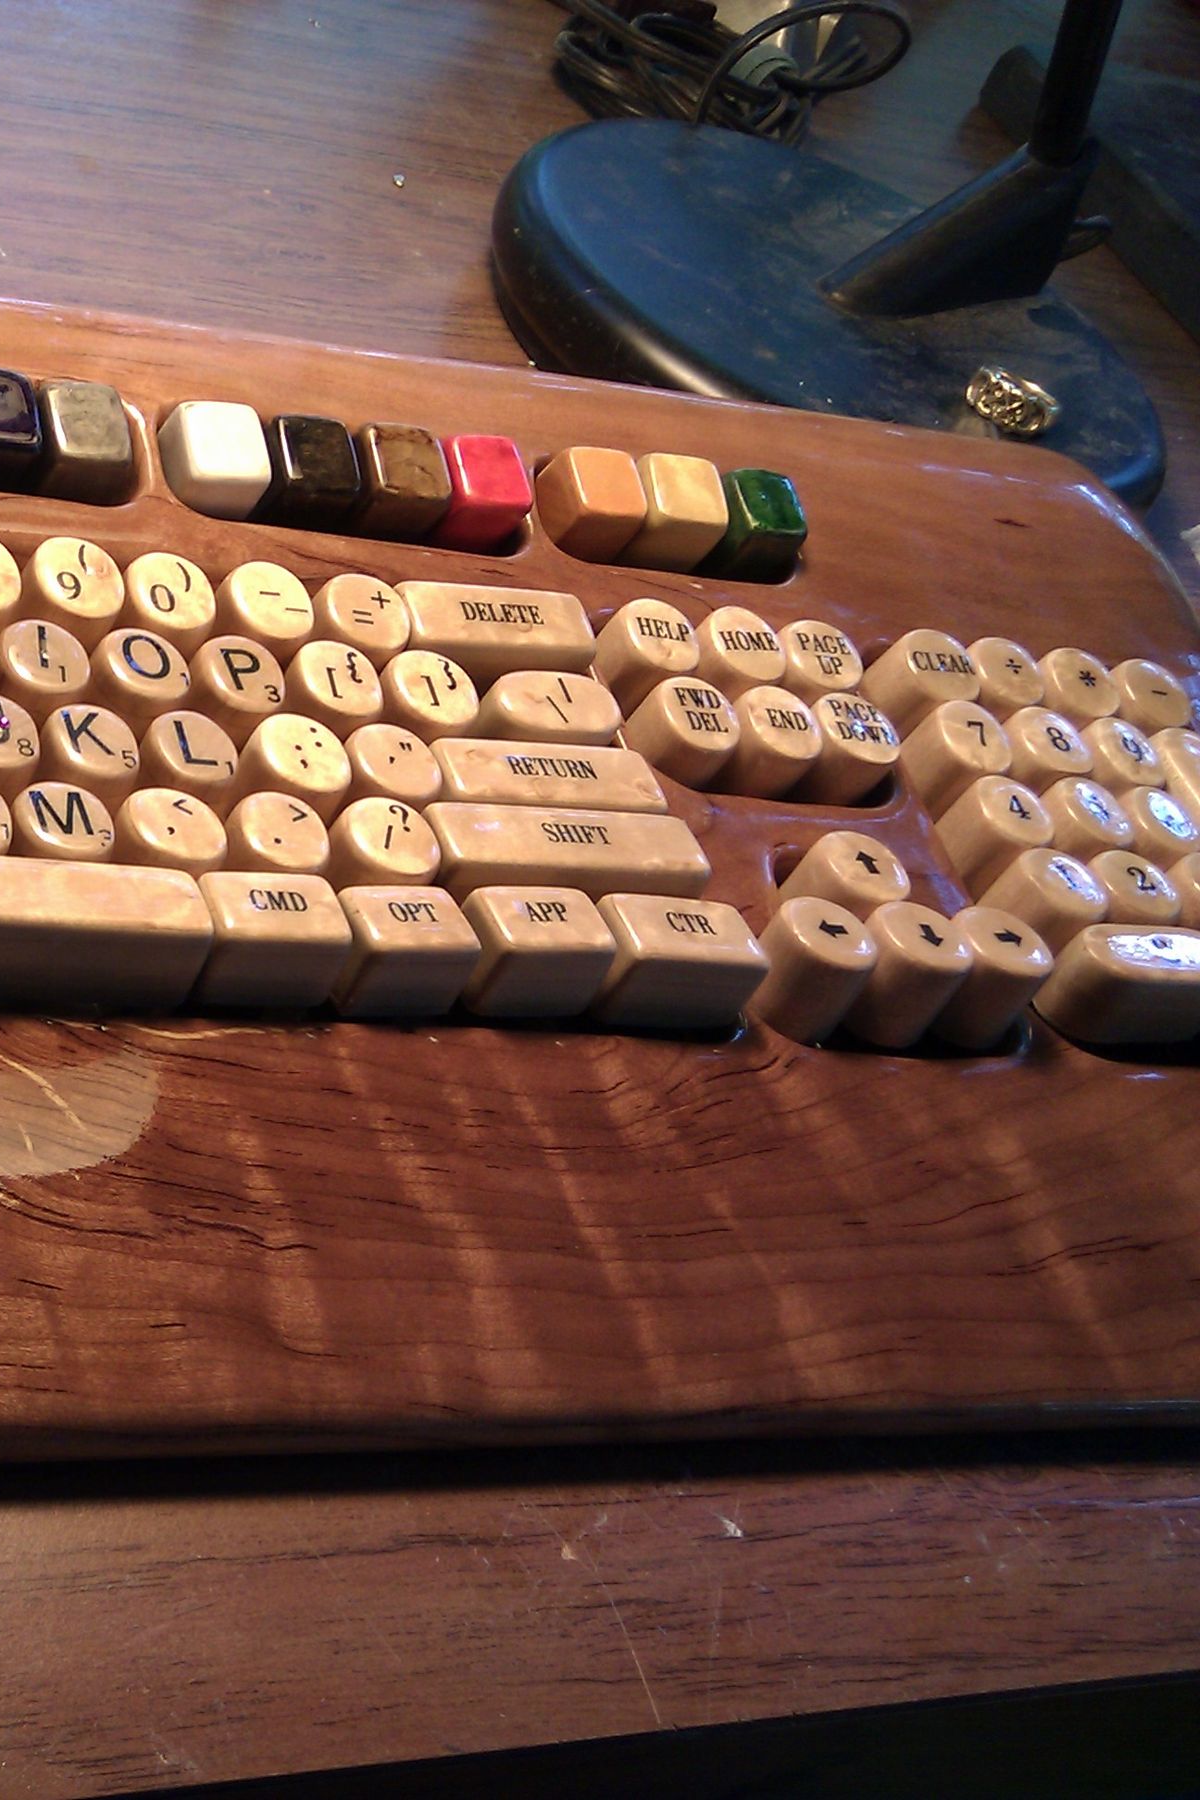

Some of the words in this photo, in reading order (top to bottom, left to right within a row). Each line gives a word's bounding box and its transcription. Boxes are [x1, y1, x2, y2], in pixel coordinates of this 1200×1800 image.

[460, 600, 544, 625] DELETE
[636, 616, 690, 642] HELP
[719, 631, 779, 652] HOME
[796, 632, 851, 655] PAGE
[122, 634, 171, 679] O
[817, 655, 843, 676] UP
[912, 651, 976, 676] CLEAR
[220, 648, 261, 691] P
[673, 686, 722, 709] FWD
[686, 710, 729, 733] DEL
[766, 708, 809, 732] END
[60, 709, 115, 756] K
[173, 720, 218, 766] L
[967, 720, 987, 746] 7
[1046, 726, 1071, 752] 8
[506, 756, 598, 780] RETURN
[28, 791, 94, 835] M
[541, 822, 611, 845] SHIFT
[249, 889, 308, 913] CMD
[388, 902, 439, 923] OPT
[524, 901, 568, 922] APP
[666, 911, 718, 936] CTR
